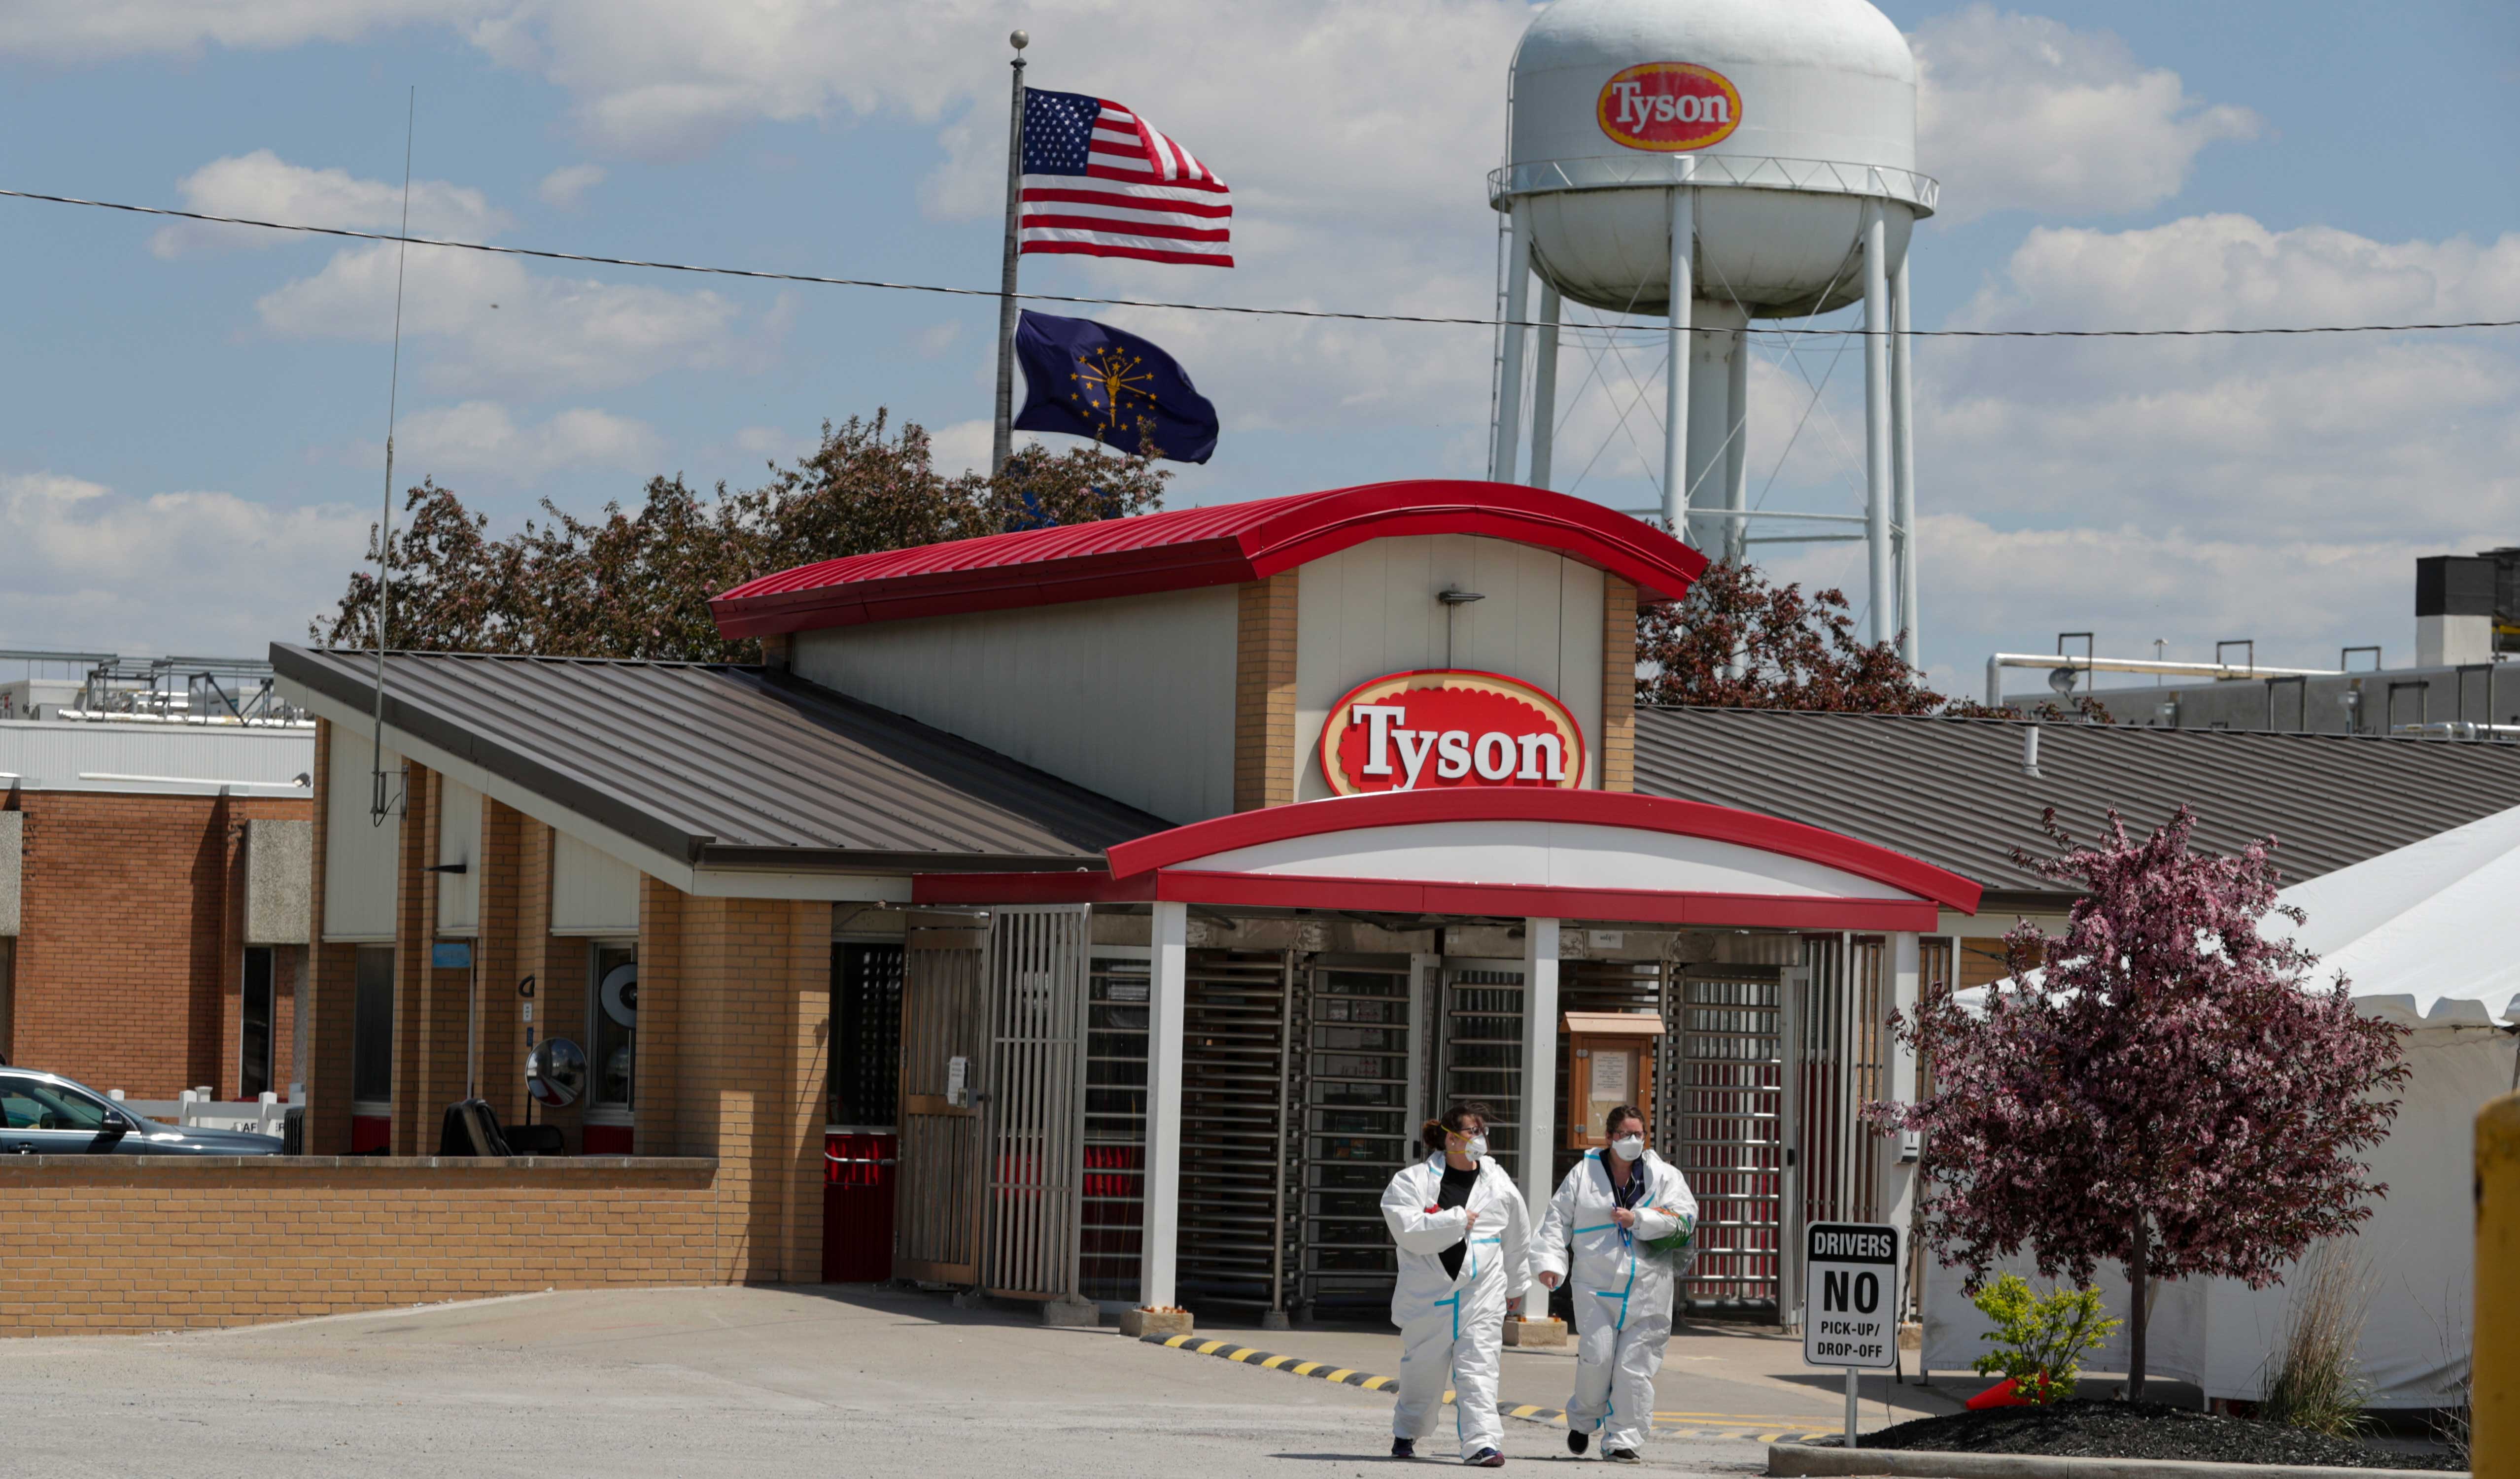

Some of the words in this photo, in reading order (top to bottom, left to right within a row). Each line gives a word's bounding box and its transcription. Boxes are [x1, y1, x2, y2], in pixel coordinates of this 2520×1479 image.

[1613, 82, 1730, 134] Tyson
[1353, 705, 1565, 790] Tyson
[1814, 1233, 1891, 1257] DRIVERS
[1824, 1271, 1879, 1314] NO
[1821, 1321, 1880, 1336] PICK-UP/
[1817, 1342, 1882, 1357] DROP-OFF
